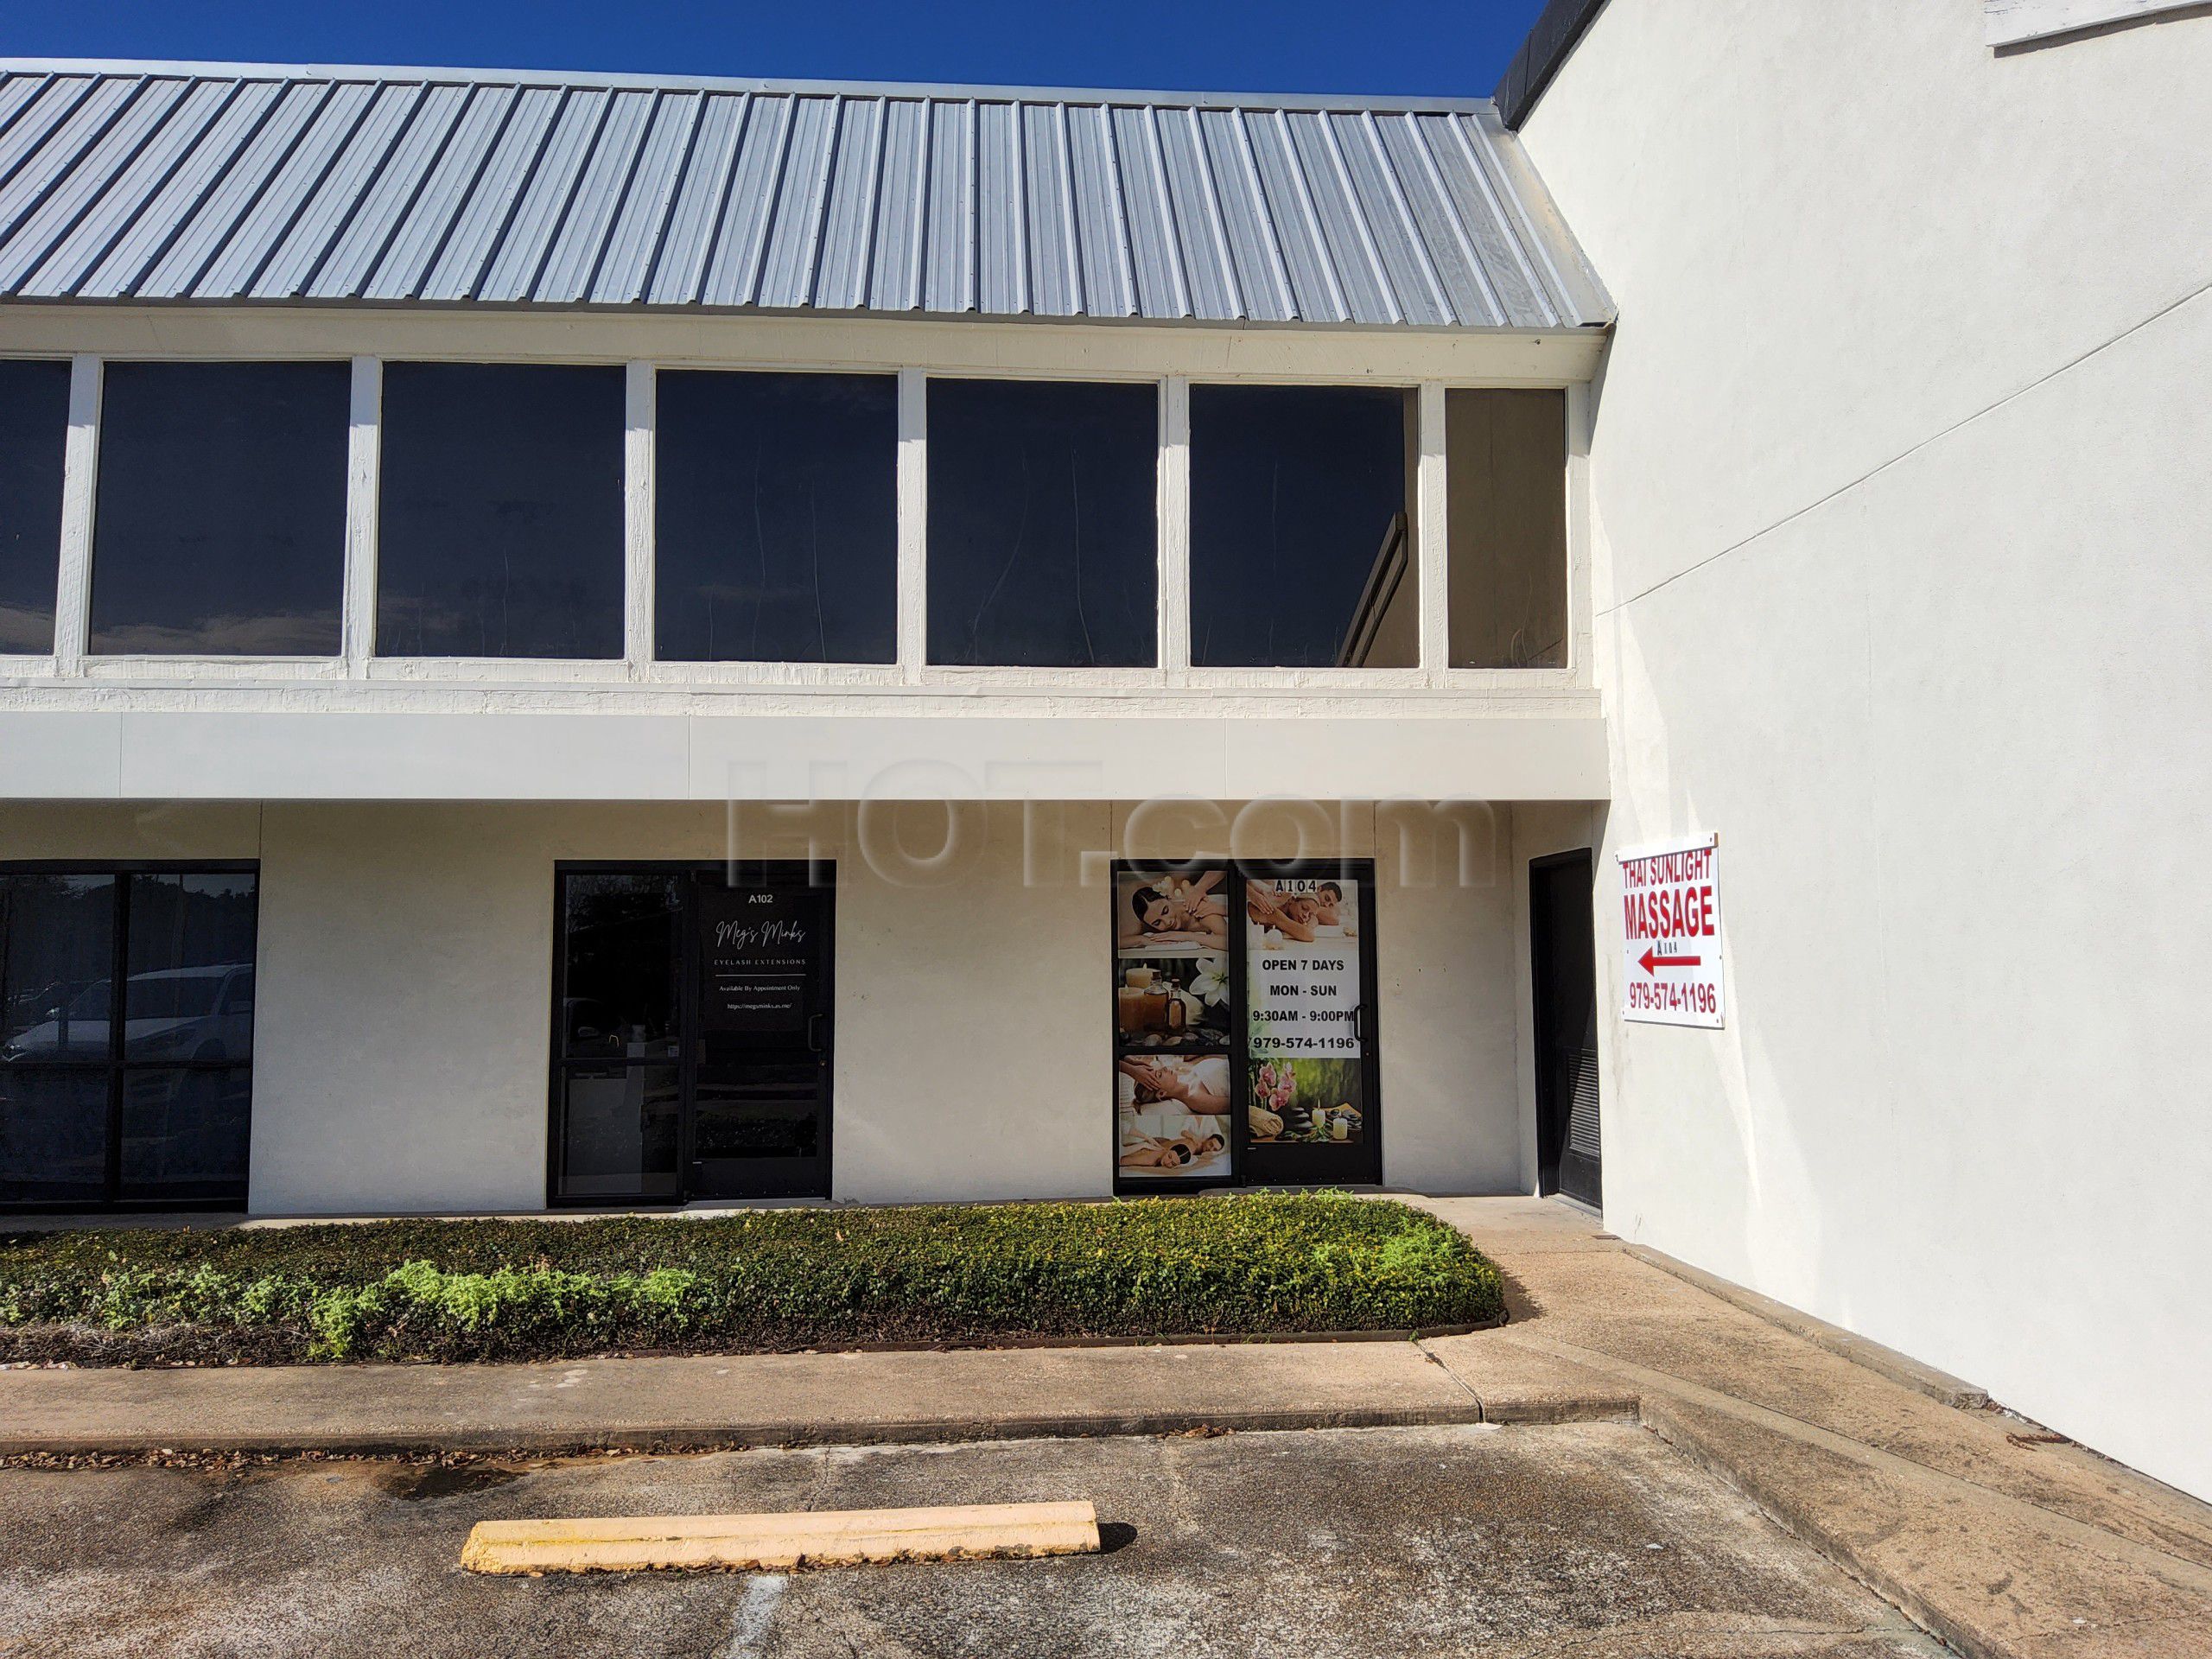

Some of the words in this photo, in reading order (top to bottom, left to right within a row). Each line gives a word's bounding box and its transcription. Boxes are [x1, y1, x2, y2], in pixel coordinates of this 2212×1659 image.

[1623, 860, 1647, 889] THAI
[1650, 849, 1713, 887] SUNLIGHT
[1275, 880, 1317, 893] A104
[748, 894, 773, 904] A102
[1624, 886, 1715, 940] MASSAGE
[715, 920, 759, 950] Meg's
[760, 920, 806, 947] Minks
[1262, 959, 1296, 971] OPEN
[1300, 960, 1308, 970] 7
[1312, 959, 1344, 971] DAYS
[1269, 985, 1299, 995] MON
[1310, 985, 1337, 995] SUN
[1630, 982, 1716, 1014] 979-574-1196
[1253, 1010, 1298, 1021] 9:30AM
[1310, 1010, 1354, 1021] 9:00PM
[1253, 1037, 1355, 1049] 979-574-1196
